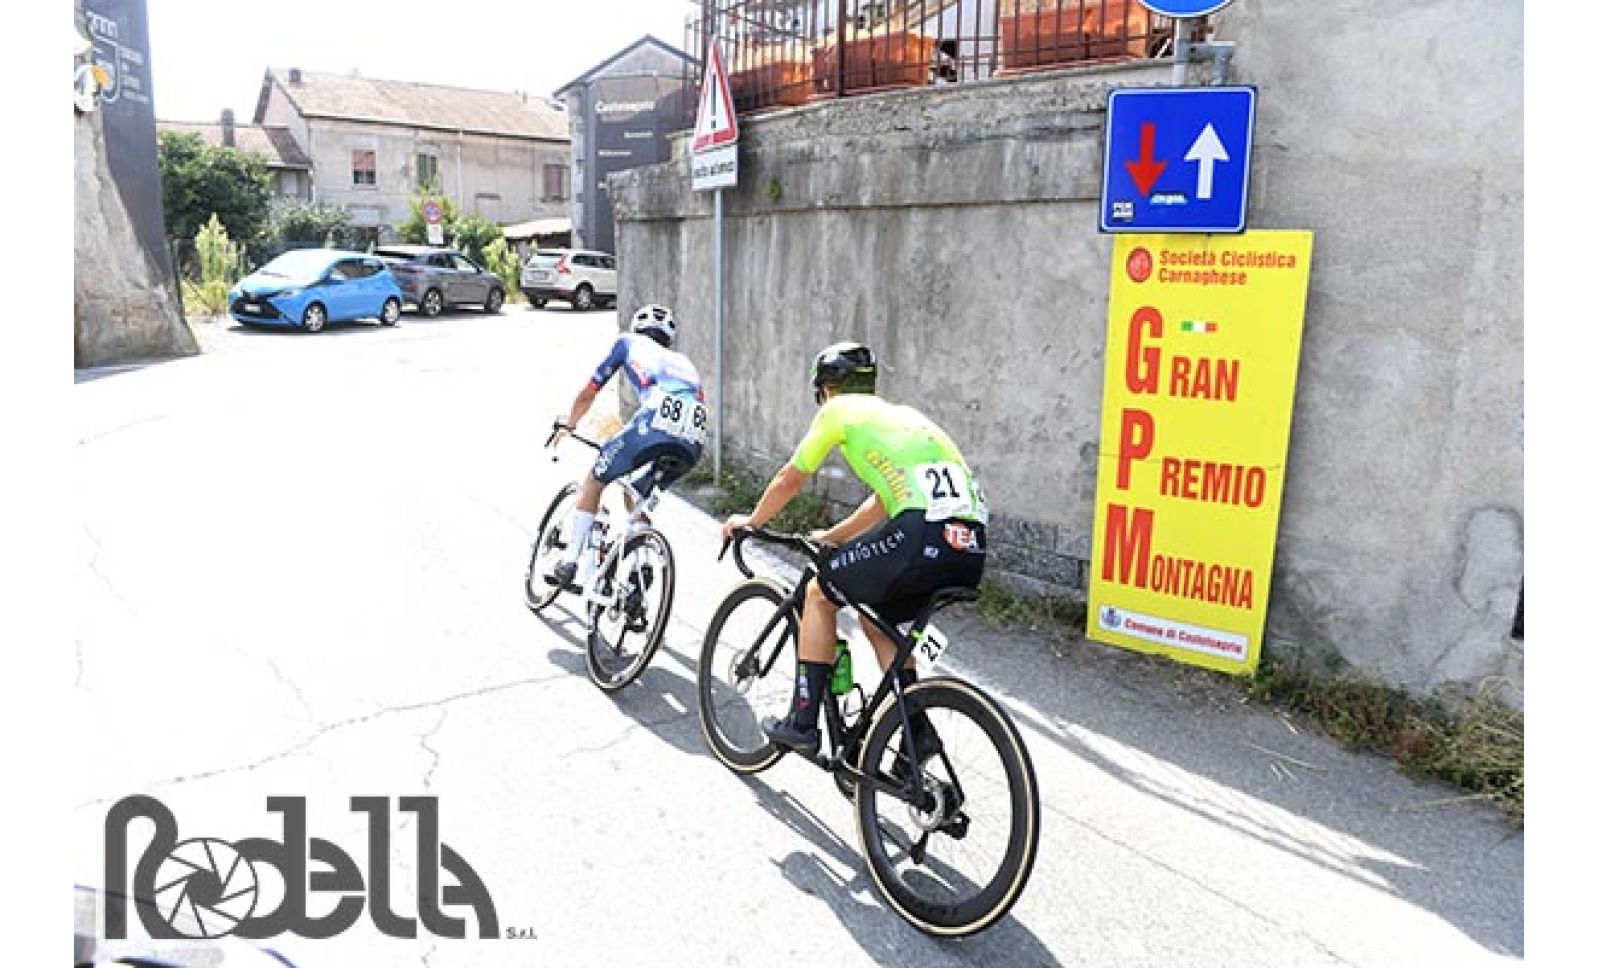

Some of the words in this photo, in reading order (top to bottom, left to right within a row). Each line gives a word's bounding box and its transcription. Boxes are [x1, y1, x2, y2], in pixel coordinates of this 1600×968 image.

[1159, 250, 1215, 266] Società
[1220, 250, 1296, 268] Ciclistica
[1159, 268, 1247, 285] Carnaghese
[660, 395, 682, 422] 68
[925, 467, 960, 499] 21
[1102, 502, 1253, 610] MONTAGNA
[920, 634, 941, 662] 21
